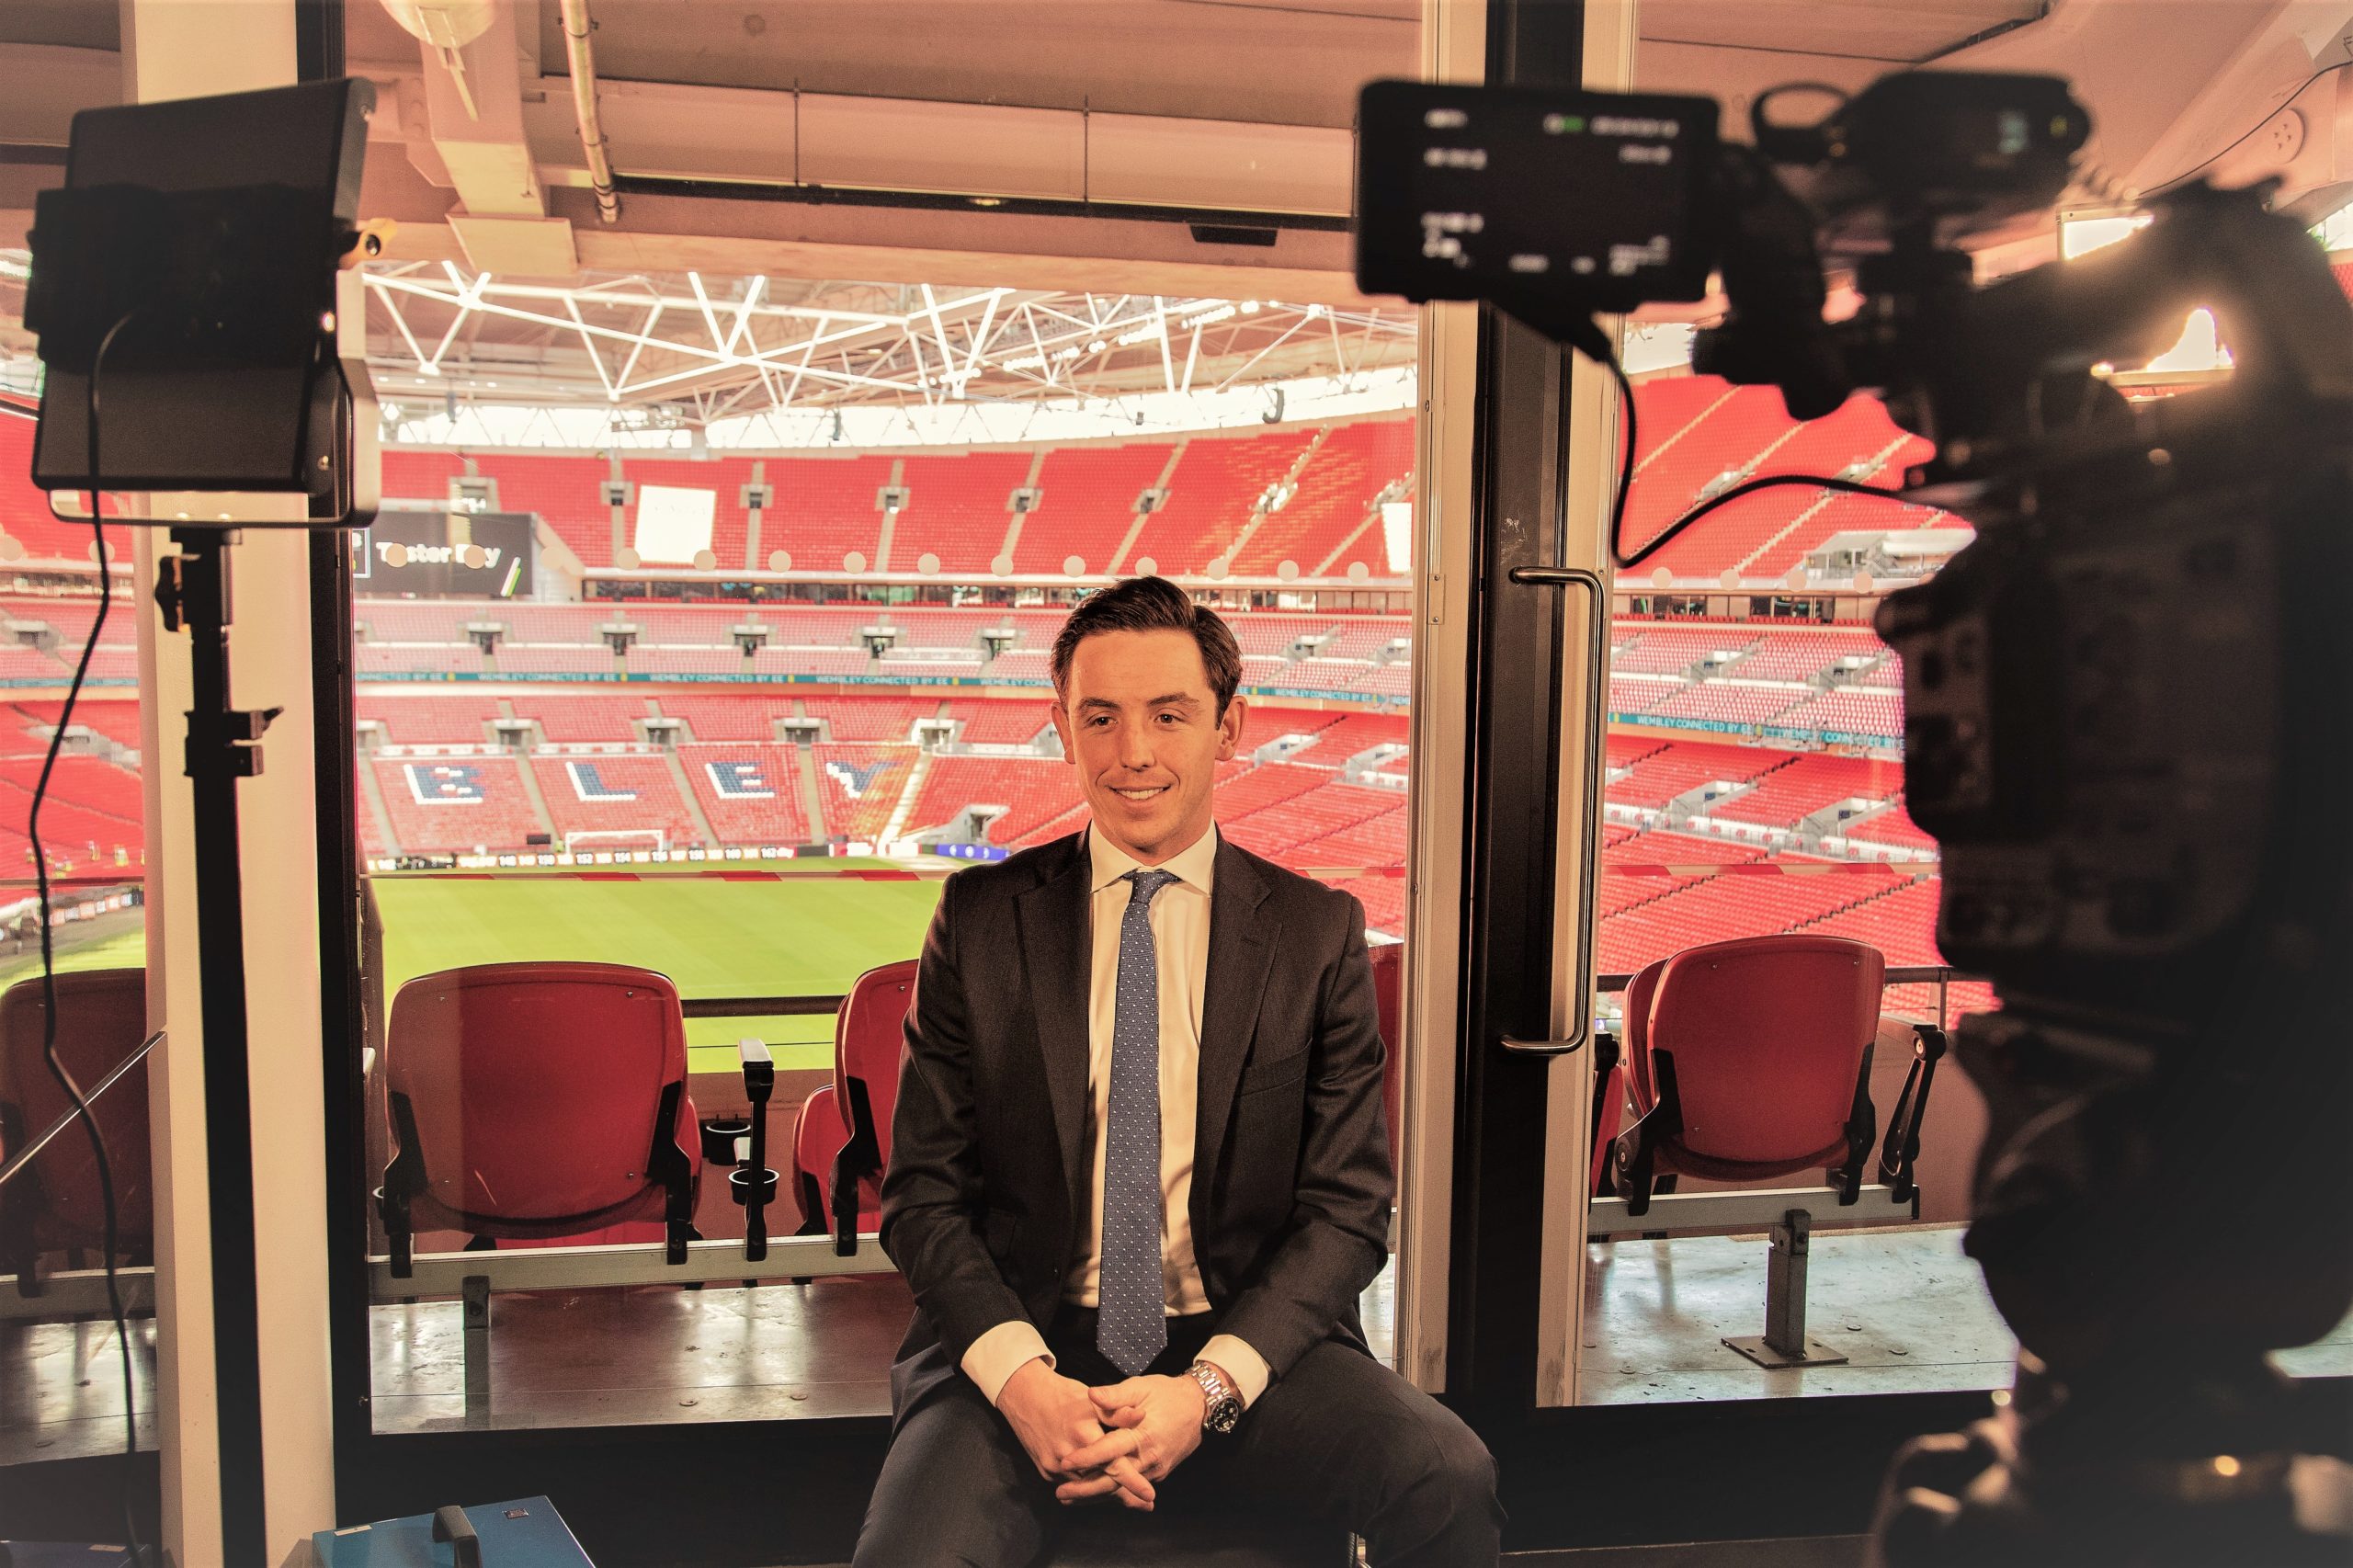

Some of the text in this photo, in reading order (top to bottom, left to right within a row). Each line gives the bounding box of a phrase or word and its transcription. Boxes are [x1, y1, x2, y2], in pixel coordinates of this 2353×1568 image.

[376, 541, 452, 563] Tster
[650, 674, 695, 682] WEMBLEY
[696, 674, 754, 682] CONNECTED
[816, 676, 862, 684] WEMBLEY
[863, 676, 919, 685] CONNECTED
[1310, 690, 1350, 701] CONNECTED
[1637, 715, 1676, 728] WEMBLEY
[1677, 718, 1724, 732] CONNECTED
[1728, 722, 1741, 733] BY
